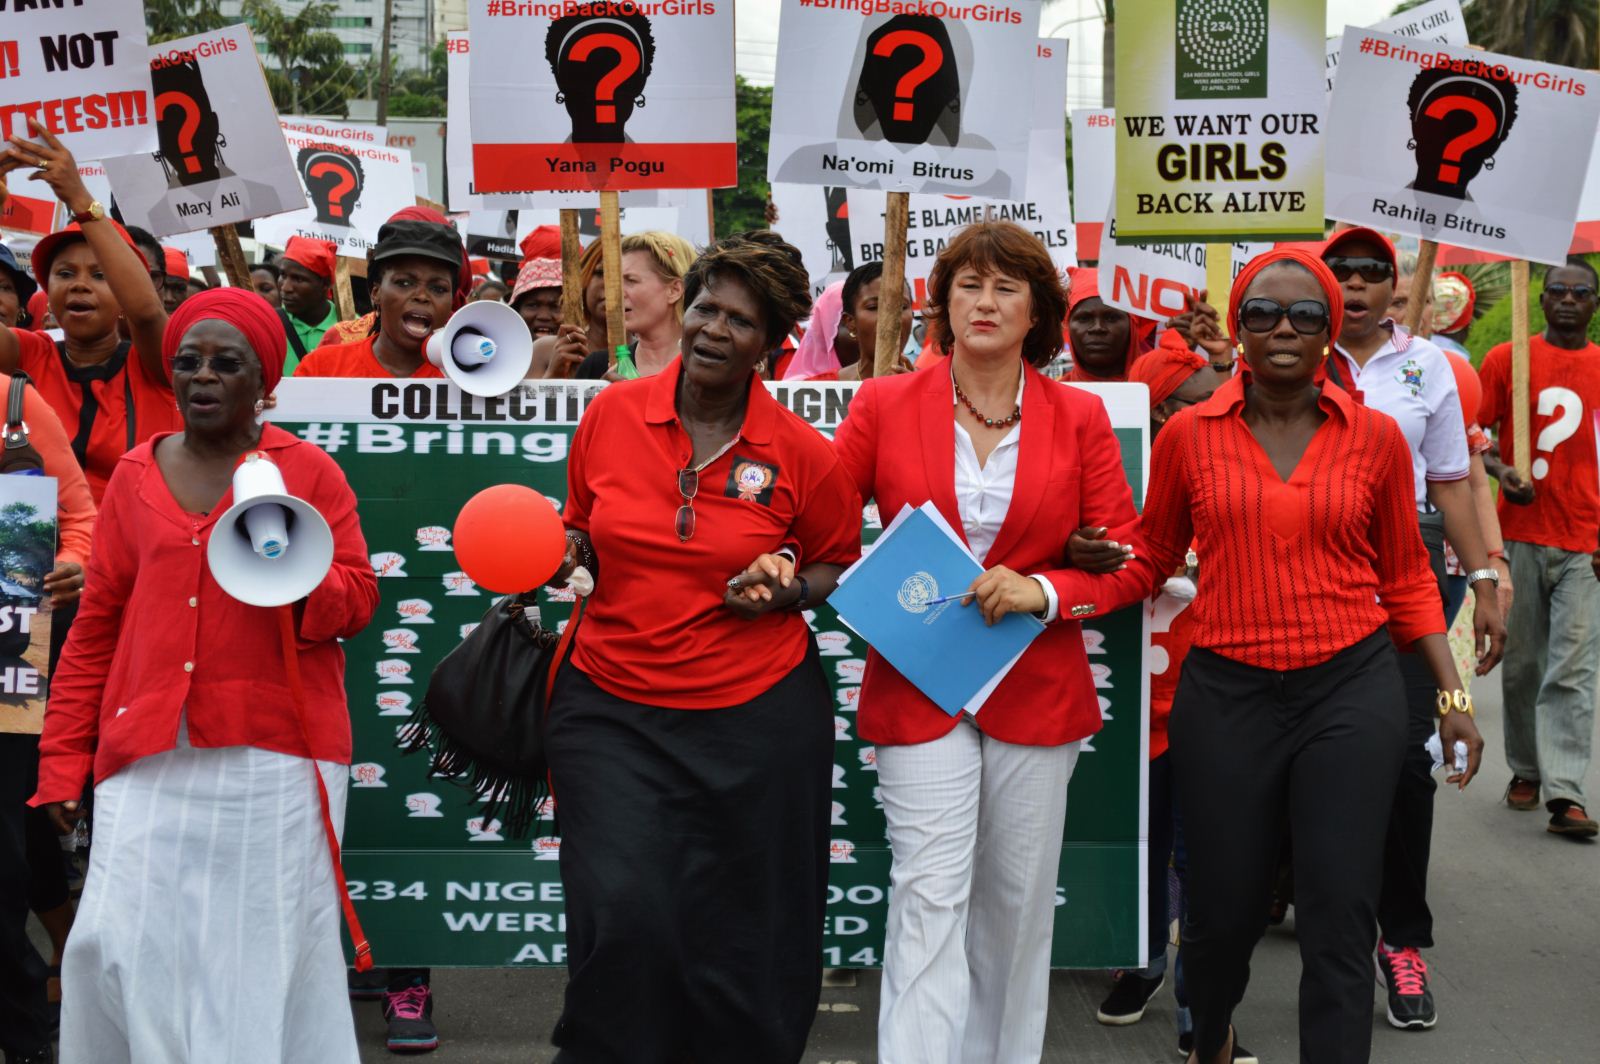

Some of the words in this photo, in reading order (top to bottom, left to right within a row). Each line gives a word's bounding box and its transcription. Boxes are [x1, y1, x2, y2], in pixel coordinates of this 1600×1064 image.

[487, 0, 715, 20] #BringBackOurGirls
[1421, 9, 1454, 30] GIRL
[1210, 21, 1233, 32] 234
[40, 31, 118, 72] NOT
[1360, 37, 1586, 96] #BringBackOurGirls
[1124, 117, 1164, 137] WE
[1174, 115, 1251, 136] WANT
[1261, 114, 1319, 134] OUR
[545, 157, 597, 173] Yana
[609, 158, 664, 176] Pogu
[822, 154, 894, 175] Na'omi
[912, 161, 975, 181] Bitrus
[1157, 142, 1288, 182] GIRLS
[176, 201, 212, 217] Mary
[220, 192, 240, 208] Ali
[1137, 193, 1214, 214] BACK
[1222, 191, 1305, 213] ALIVE
[922, 205, 982, 228] BLAME
[986, 202, 1042, 224] GAME,
[1372, 198, 1437, 225] Rahila
[1443, 213, 1506, 239] Bitrus
[861, 240, 918, 262] BRG
[1112, 264, 1200, 317] NO
[346, 880, 428, 900] 234
